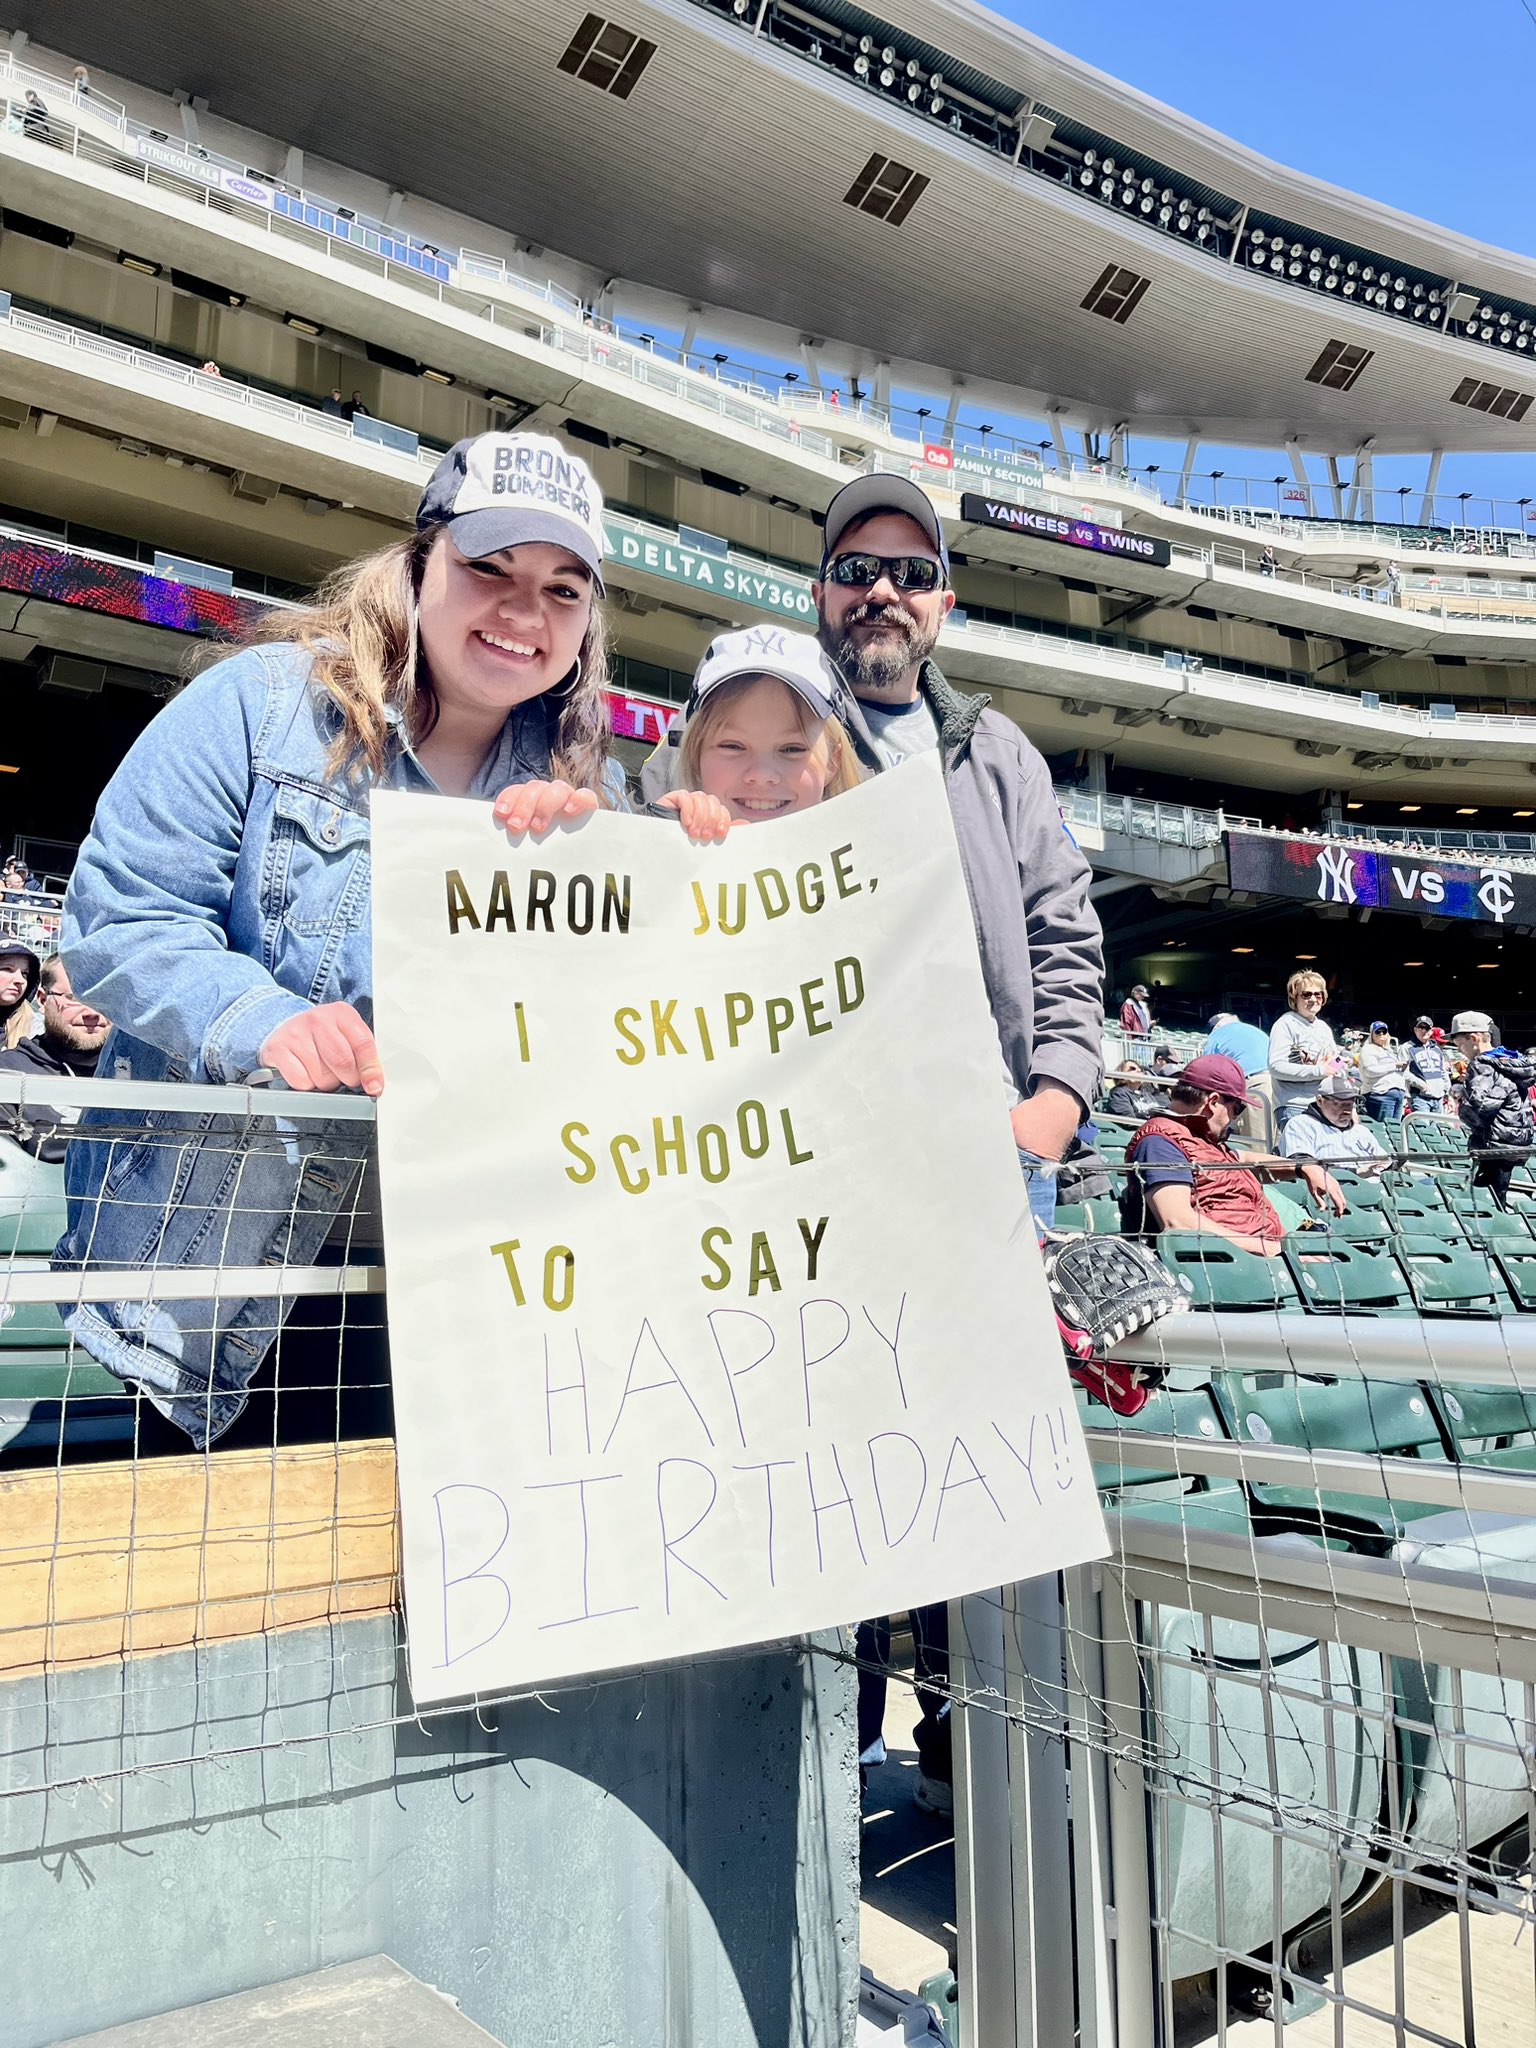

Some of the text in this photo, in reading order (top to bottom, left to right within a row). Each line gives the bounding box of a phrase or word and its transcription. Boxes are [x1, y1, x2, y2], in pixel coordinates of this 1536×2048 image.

[140, 142, 198, 173] STRIKEOUT
[230, 179, 265, 200] Carrier
[494, 447, 589, 500] BRONX
[927, 450, 949, 465] Cub
[953, 457, 1042, 489] FAMILY SECTION
[492, 473, 591, 525] BOMBERS
[1287, 490, 1305, 500] 326
[985, 503, 1155, 556] YANKEES VS TWINS
[622, 535, 714, 585] DELTA
[445, 842, 879, 936] AARON JUDGE,
[1392, 867, 1445, 903] VS
[514, 956, 866, 1066] I SKIPPED
[560, 1099, 815, 1195] SCHOOL
[489, 1216, 830, 1312] TO SAY
[544, 1291, 907, 1455] HAPPY
